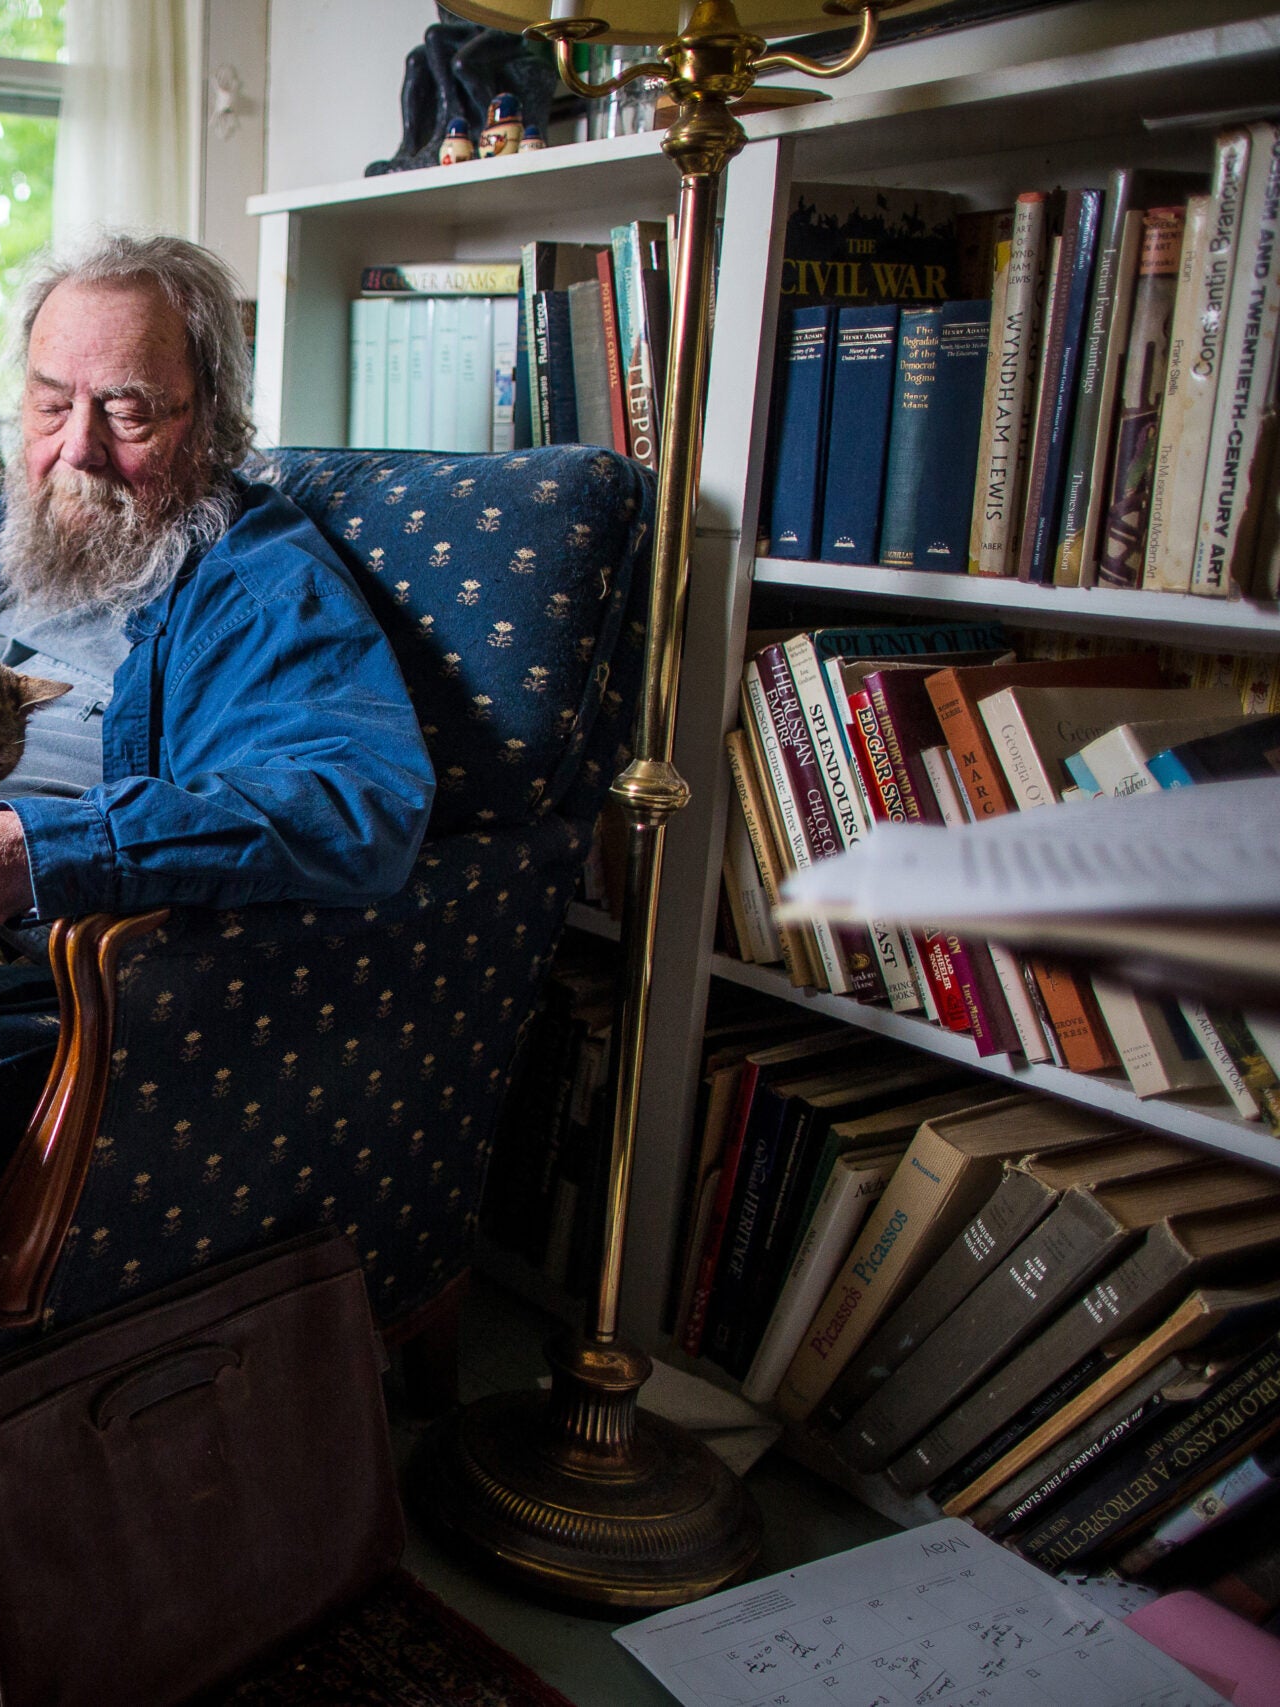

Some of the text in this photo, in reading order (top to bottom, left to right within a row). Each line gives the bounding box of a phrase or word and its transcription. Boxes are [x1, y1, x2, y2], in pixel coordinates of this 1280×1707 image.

[1016, 225, 1032, 234] ART
[1018, 211, 1033, 221] THE
[847, 238, 877, 254] THE
[446, 272, 497, 289] ADAMS
[781, 259, 949, 298] CIVIL WAR
[1011, 263, 1031, 271] HAM
[601, 282, 618, 388] POETRY IN CRYSTAL
[915, 326, 934, 335] The
[921, 349, 936, 358] the
[1170, 339, 1184, 366] Frank
[905, 372, 935, 385] Dogma
[1167, 368, 1180, 397] Stella
[904, 392, 928, 401] Henry
[1059, 247, 1117, 571] Lucian Freud paintings Thames and Hudson
[1205, 226, 1275, 585] AND TWENTIETH-CENTURY ART
[625, 356, 654, 469] TIEPO
[984, 310, 1024, 521] WYNDHAM LEWIS
[1159, 444, 1171, 464] The
[1153, 466, 1168, 511] Museum
[1147, 522, 1161, 562] Modern
[1144, 562, 1156, 579] Art
[820, 627, 1004, 656] SPLENDOURS
[769, 657, 793, 697] THE
[763, 687, 793, 751] EMPIRE
[780, 696, 814, 768] RUSSIAN
[726, 744, 741, 773] CAVE
[854, 705, 894, 784] EDGAR
[879, 781, 907, 825] SNO
[869, 688, 921, 821] THE HISTORY AND ART
[993, 721, 1039, 784] Georgia
[808, 702, 858, 837] SPLENDOURS
[734, 774, 747, 801] BIRDS
[744, 808, 755, 827] Ted
[747, 678, 828, 953] Francesco Clemente: Three Museum
[804, 816, 818, 842] MAX
[805, 787, 832, 840] CHLOE
[748, 828, 764, 859] Hughes
[927, 951, 942, 982] SNOW
[931, 942, 952, 990] WHEELER
[1055, 1016, 1084, 1029] GROVE
[1196, 1015, 1248, 1096] ART, NEW YORK
[910, 1156, 941, 1186] Duncan
[959, 1232, 984, 1262] ROUAULT
[966, 1225, 991, 1256] MUNCH
[972, 1217, 998, 1248] MATISSE
[1023, 1257, 1044, 1283] PICASSO
[1031, 1255, 1047, 1274] FROM
[805, 1282, 865, 1360] Picasso's
[849, 1204, 912, 1286] Picassos
[1007, 1265, 1037, 1302] SURREALISM
[1104, 1284, 1120, 1303] FROM
[1093, 1283, 1120, 1317] AUDELAIRE
[1093, 1298, 1104, 1310] TO
[1235, 1367, 1280, 1419] ABLO
[1106, 1416, 1132, 1440] AGE
[1166, 1402, 1243, 1473] PICASSO:
[1025, 1351, 1280, 1552] THE MUSEUM OF MODERN ART NEW YORK
[1066, 1441, 1101, 1472] BARNS
[1037, 1473, 1062, 1496] ERIC
[1150, 1459, 1172, 1482] A
[1005, 1490, 1042, 1522] SLOANE
[1035, 1467, 1158, 1577] RETROSPECTIVE
[920, 1536, 971, 1560] May
[822, 1567, 974, 1625] 26 28 29
[773, 1604, 1028, 1706] 19 20 21 22 23 24
[1024, 1647, 1090, 1680] 12 13
